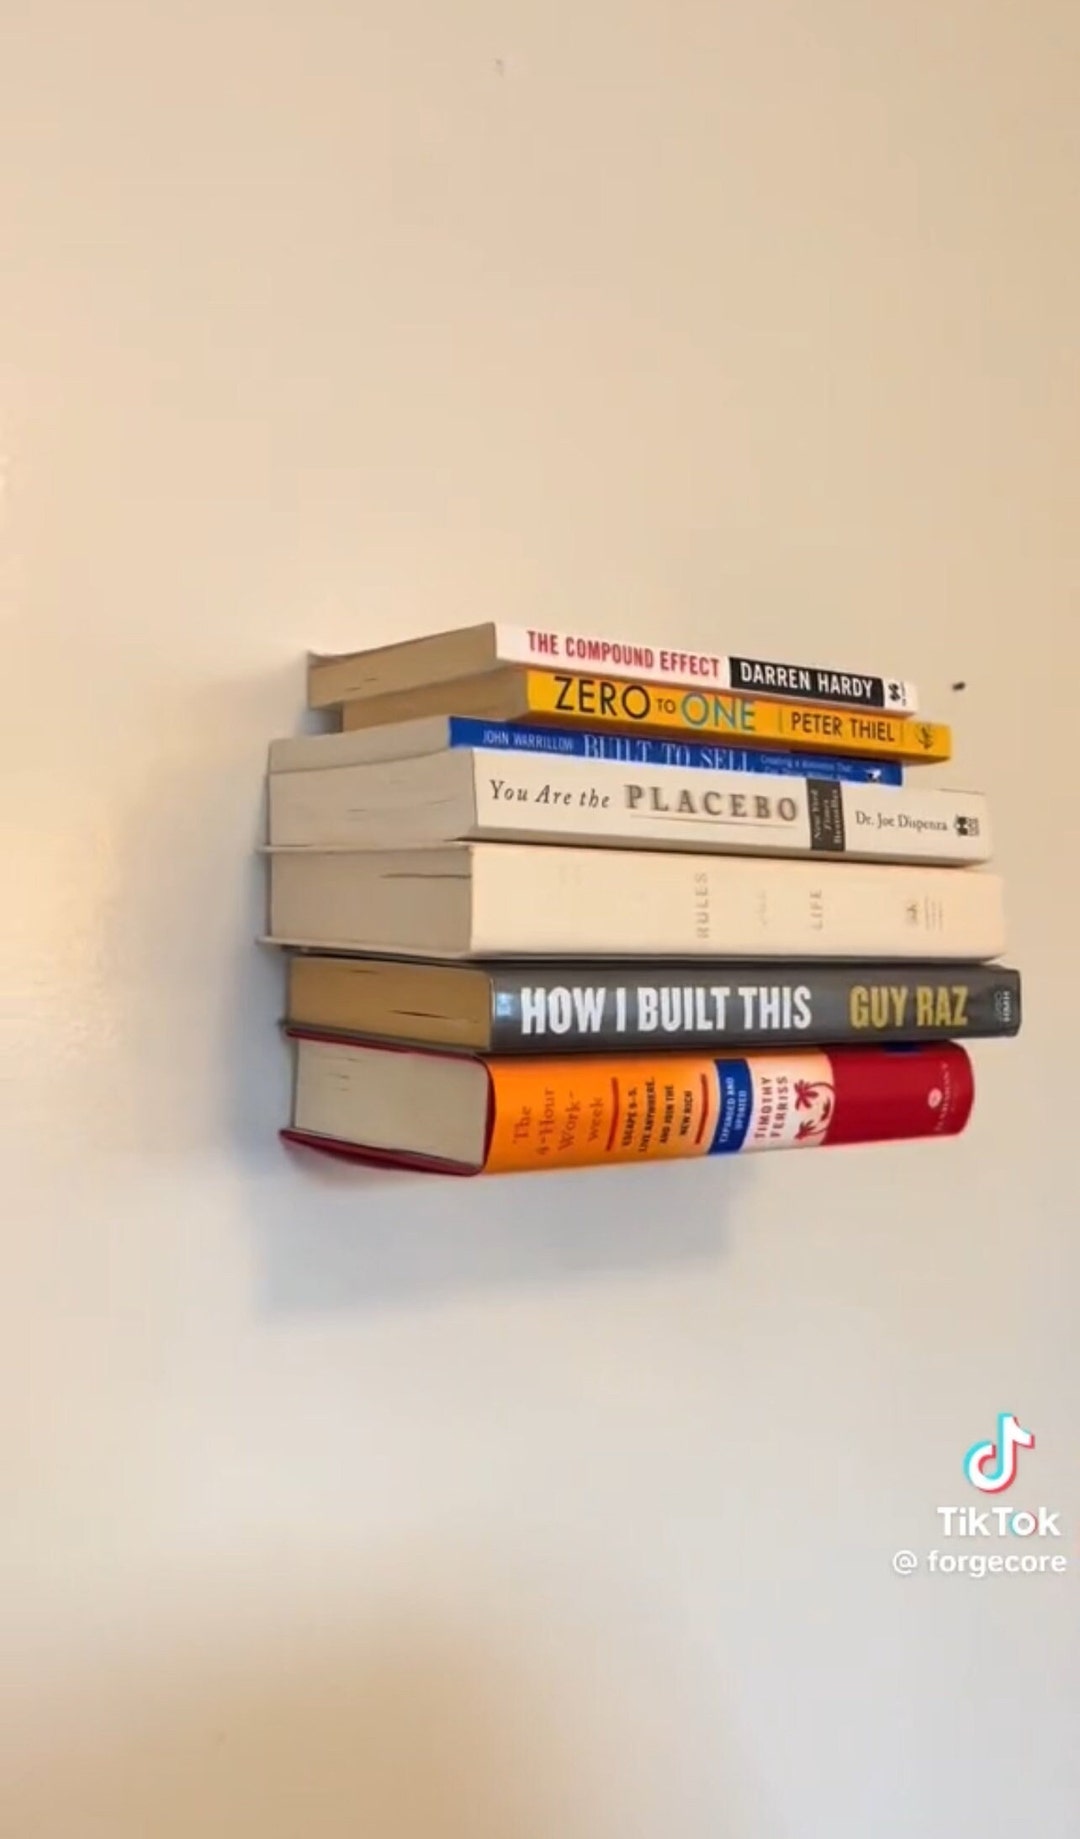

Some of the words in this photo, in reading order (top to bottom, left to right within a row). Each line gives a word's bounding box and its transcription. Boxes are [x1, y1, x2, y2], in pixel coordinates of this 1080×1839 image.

[527, 630, 559, 655] THE
[566, 637, 654, 668] COMPOUND
[660, 650, 720, 678] EFFECT
[740, 661, 811, 691] DARREN
[817, 672, 873, 699] HARDY
[554, 676, 651, 719] ZERO
[657, 698, 676, 714] TO
[681, 692, 756, 731] ONE
[482, 729, 509, 745] JOHN
[513, 732, 574, 751] WARRILLOW
[791, 711, 843, 737] PETER
[851, 718, 896, 742] THIEL
[583, 734, 651, 763] BUILT
[662, 743, 691, 768] TO
[700, 747, 754, 773] SELL
[489, 779, 528, 800] You
[534, 784, 572, 806] Are
[579, 788, 610, 808] the
[624, 784, 799, 822] PLACEBO
[855, 811, 875, 826] Dr.
[877, 812, 896, 829] Joe
[898, 814, 948, 832] Dispenza
[695, 872, 710, 939] RULES
[809, 889, 823, 931] LIFE
[520, 986, 606, 1034] HOW
[615, 986, 626, 1032] I
[637, 986, 730, 1032] BUILT
[738, 985, 813, 1030] THIS
[850, 985, 908, 1028] GUY
[916, 985, 968, 1028] RAZ
[513, 1105, 532, 1144] The
[535, 1088, 556, 1155] 4-Hour
[588, 1096, 604, 1142] week
[754, 1076, 772, 1139] TIMOTHY
[770, 1076, 789, 1138] FERRISS
